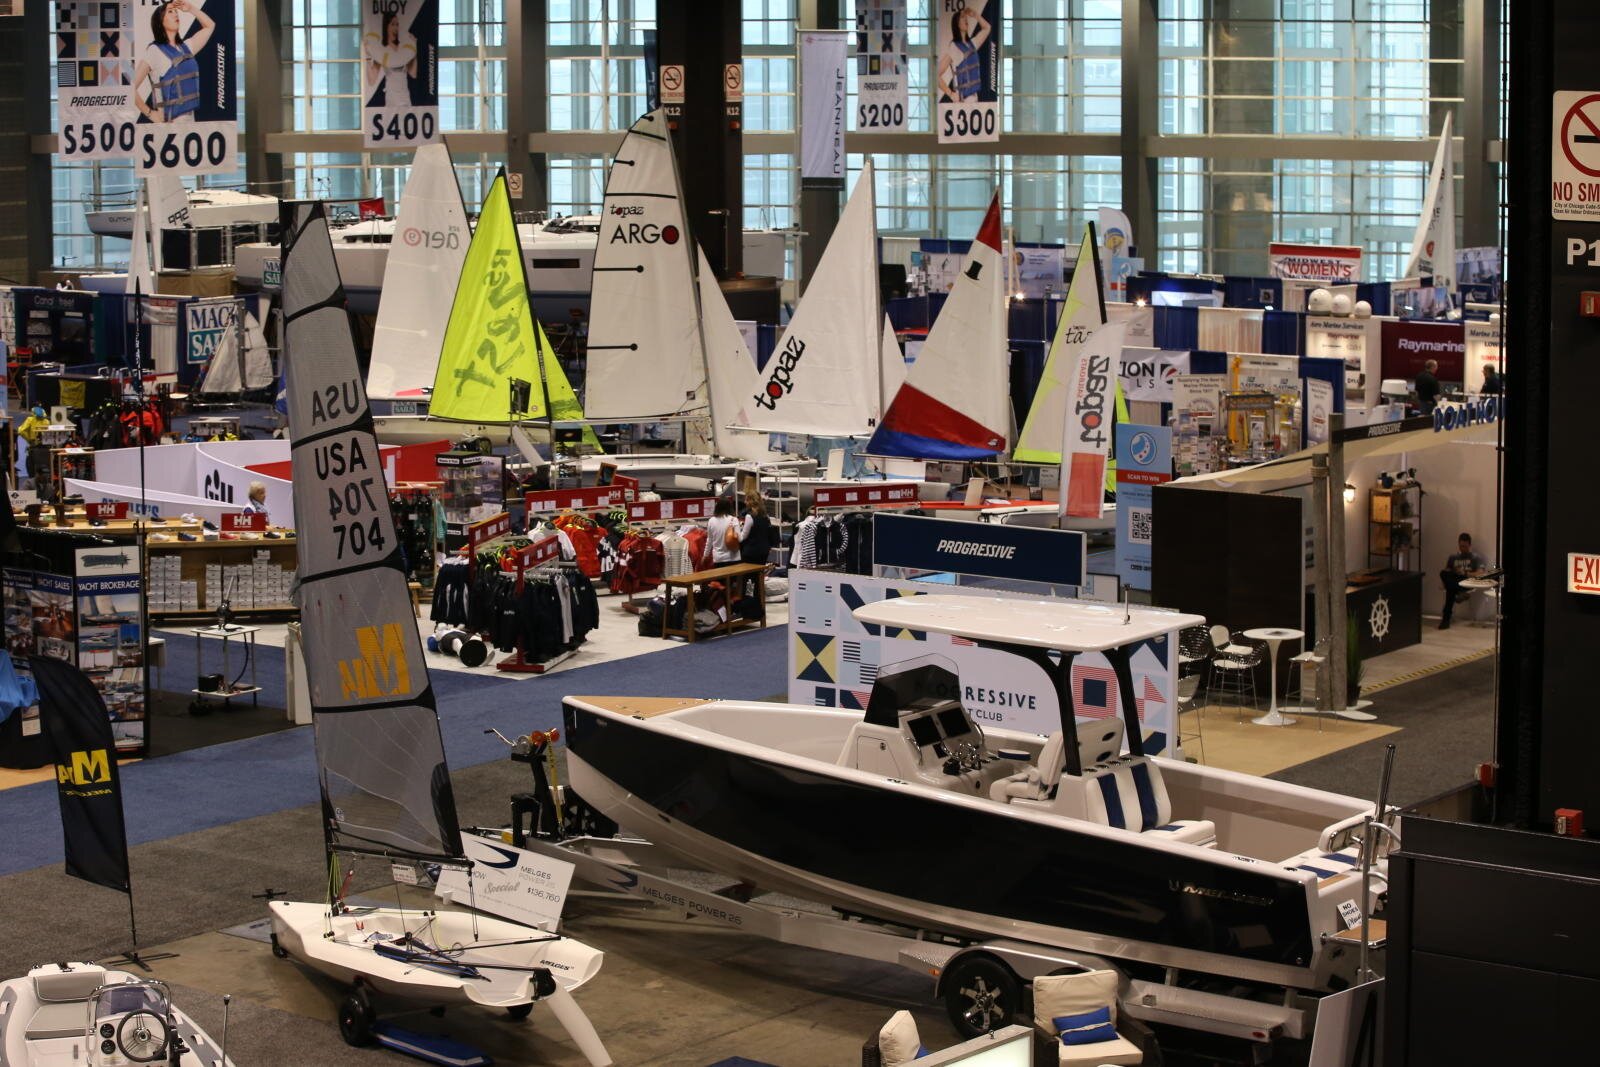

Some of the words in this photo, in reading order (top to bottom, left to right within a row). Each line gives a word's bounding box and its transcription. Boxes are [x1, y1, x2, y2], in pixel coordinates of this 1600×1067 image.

[373, 0, 407, 14] BUOY
[217, 43, 226, 109] PROGRESSIVE
[70, 95, 127, 107] PROGRESSIVE
[726, 107, 740, 116] K12
[860, 103, 904, 128] S200
[372, 112, 434, 141] S400
[833, 68, 845, 175] JEANNEAU
[944, 109, 995, 137] S300
[64, 122, 135, 154] S500
[143, 131, 226, 169] S600
[1553, 182, 1572, 201] NO
[168, 207, 190, 225] 992
[609, 203, 644, 218] topaz
[610, 223, 679, 245] ARGO
[1286, 257, 1342, 265] MIDWEST
[1288, 262, 1352, 277] WOMEN'S
[1065, 327, 1093, 344] ta
[1398, 338, 1465, 353] Raymarine
[753, 335, 806, 411] topaz
[314, 436, 367, 481] USA
[899, 487, 915, 498] HH
[97, 504, 116, 515] HH
[233, 515, 252, 526] HH
[333, 516, 386, 560] 704
[936, 539, 1017, 560] PROGRESSIVE
[55, 581, 70, 590] SALES
[79, 582, 97, 590] YACHT
[101, 580, 139, 589] BROKERAGE
[965, 686, 1037, 710] RESSIVE
[976, 709, 1003, 722] CLUB
[520, 865, 552, 880] MELGES
[642, 886, 686, 906] MELGES
[688, 901, 727, 919] POWER
